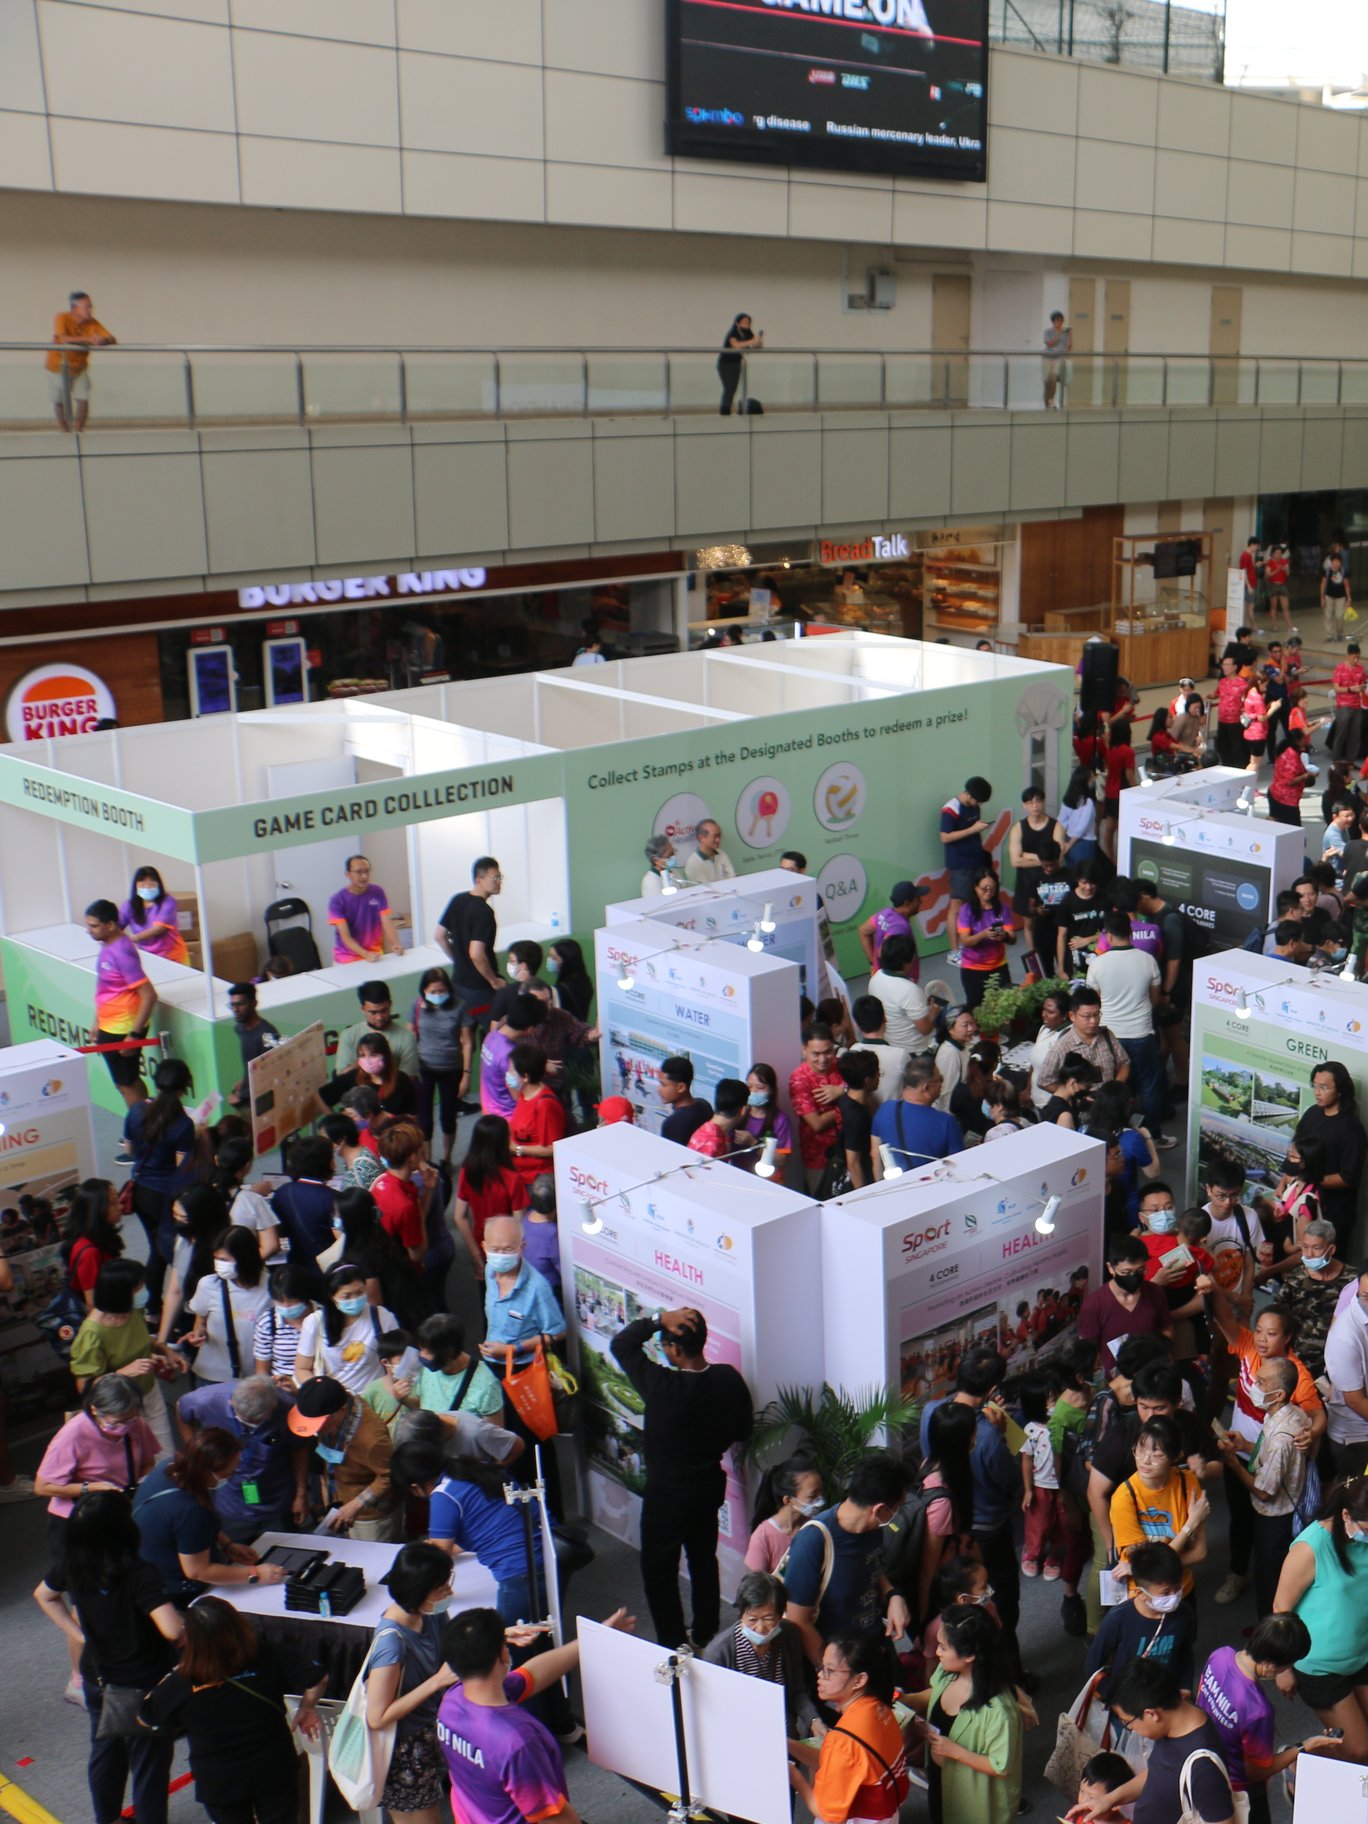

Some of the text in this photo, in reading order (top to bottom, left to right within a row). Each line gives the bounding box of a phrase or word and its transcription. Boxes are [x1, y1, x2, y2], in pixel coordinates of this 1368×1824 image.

[767, 115, 812, 132] disease
[826, 121, 869, 137] Russian
[871, 127, 924, 146] mercenary
[925, 132, 957, 148] leader,
[820, 533, 909, 564] BreadTalk
[22, 698, 98, 722] BURGER
[24, 716, 98, 741] KING
[587, 769, 639, 790] Collect
[642, 760, 694, 780] Stamps
[697, 755, 711, 769] at
[714, 750, 736, 766] the
[740, 735, 813, 761] Designated
[816, 728, 860, 747] Booths
[863, 725, 877, 738] to
[879, 718, 923, 736] redeem
[935, 708, 969, 729] prize!
[23, 777, 145, 833] REDEMPTION BOOTH
[253, 774, 515, 839] GAME CARD COLLLECTION
[824, 877, 859, 901] Q&A
[1178, 903, 1216, 922] 4 CORE
[1132, 930, 1156, 941] NILA
[1206, 976, 1240, 996] Spor
[675, 1004, 710, 1027] WATER
[1231, 1021, 1249, 1033] CORE
[1286, 1038, 1329, 1062] GREEN
[0, 1128, 40, 1153] ING
[569, 1165, 608, 1196] Sport
[902, 1218, 951, 1254] Sport
[904, 1240, 948, 1265] SINGAPORE
[654, 1249, 704, 1286] HEALTH
[929, 1263, 960, 1283] 4 CORE
[1216, 1691, 1238, 1724] NILA
[452, 1733, 485, 1769] NILA
